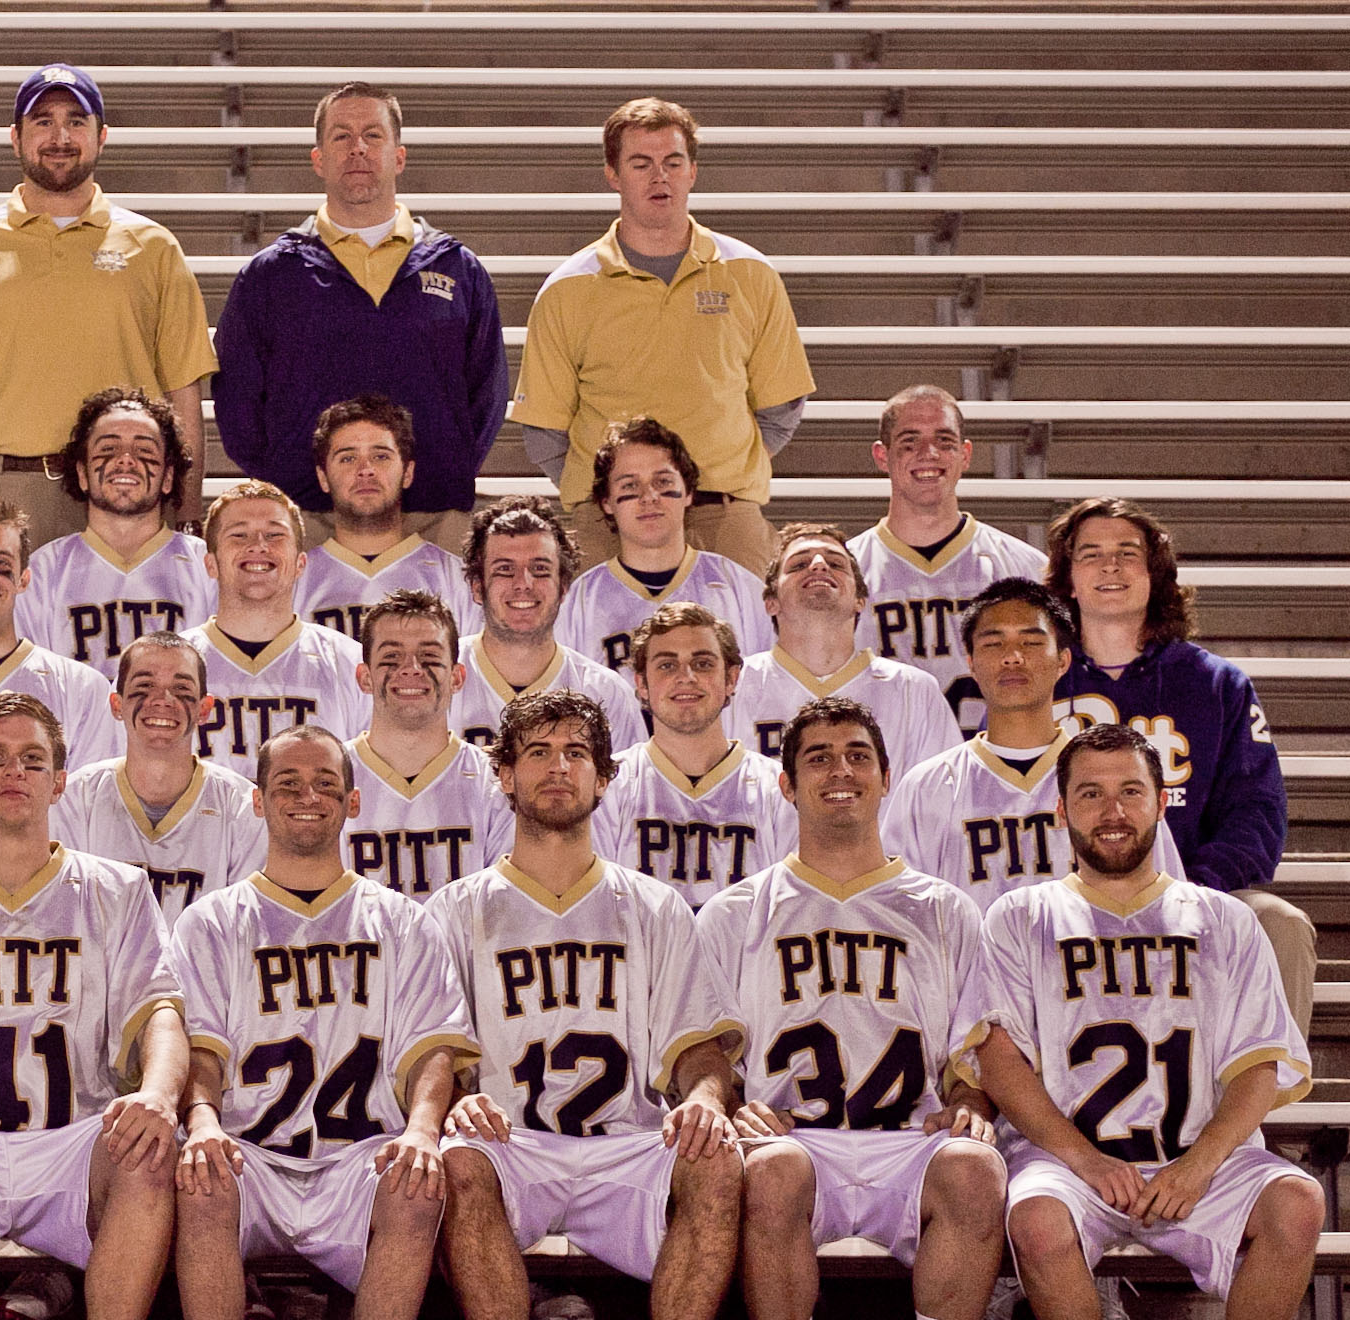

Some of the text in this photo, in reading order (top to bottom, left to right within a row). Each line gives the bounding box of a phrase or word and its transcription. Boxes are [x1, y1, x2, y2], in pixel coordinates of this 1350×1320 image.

[418, 270, 456, 293] PITT
[872, 596, 975, 658] PIT
[349, 827, 473, 893] PITT
[636, 817, 756, 883] PITT
[962, 811, 1079, 885] PIT
[124, 862, 206, 908] TT
[252, 942, 380, 1015] PITT
[495, 942, 627, 1018] PITT
[776, 928, 907, 1004] PITT
[1059, 936, 1198, 1000] PITT
[234, 1032, 388, 1157] 24
[509, 1031, 629, 1137] 12
[765, 1019, 927, 1130] 34
[1067, 1020, 1196, 1163] 21
